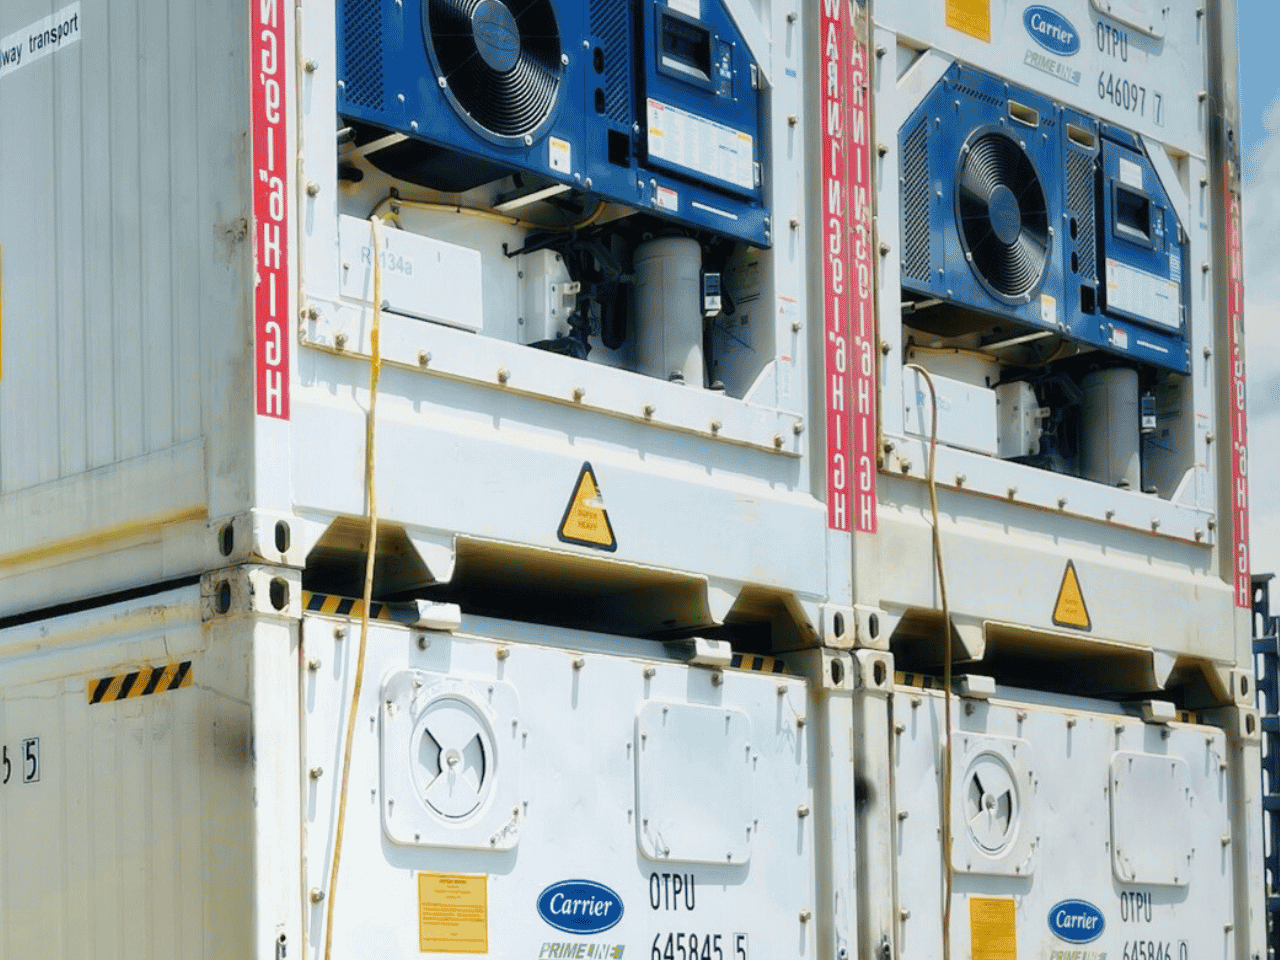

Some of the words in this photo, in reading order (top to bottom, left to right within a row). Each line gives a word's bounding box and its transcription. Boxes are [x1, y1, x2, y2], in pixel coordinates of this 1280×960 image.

[28, 13, 79, 53] transport
[1030, 13, 1074, 45] Carrier
[1095, 21, 1128, 63] OTPU
[1097, 70, 1146, 117] 646097
[25, 739, 37, 781] 5
[549, 892, 613, 917] Carrier
[649, 872, 696, 911] OTPU
[1120, 891, 1153, 923] OTPU
[1055, 909, 1099, 930] Carrier
